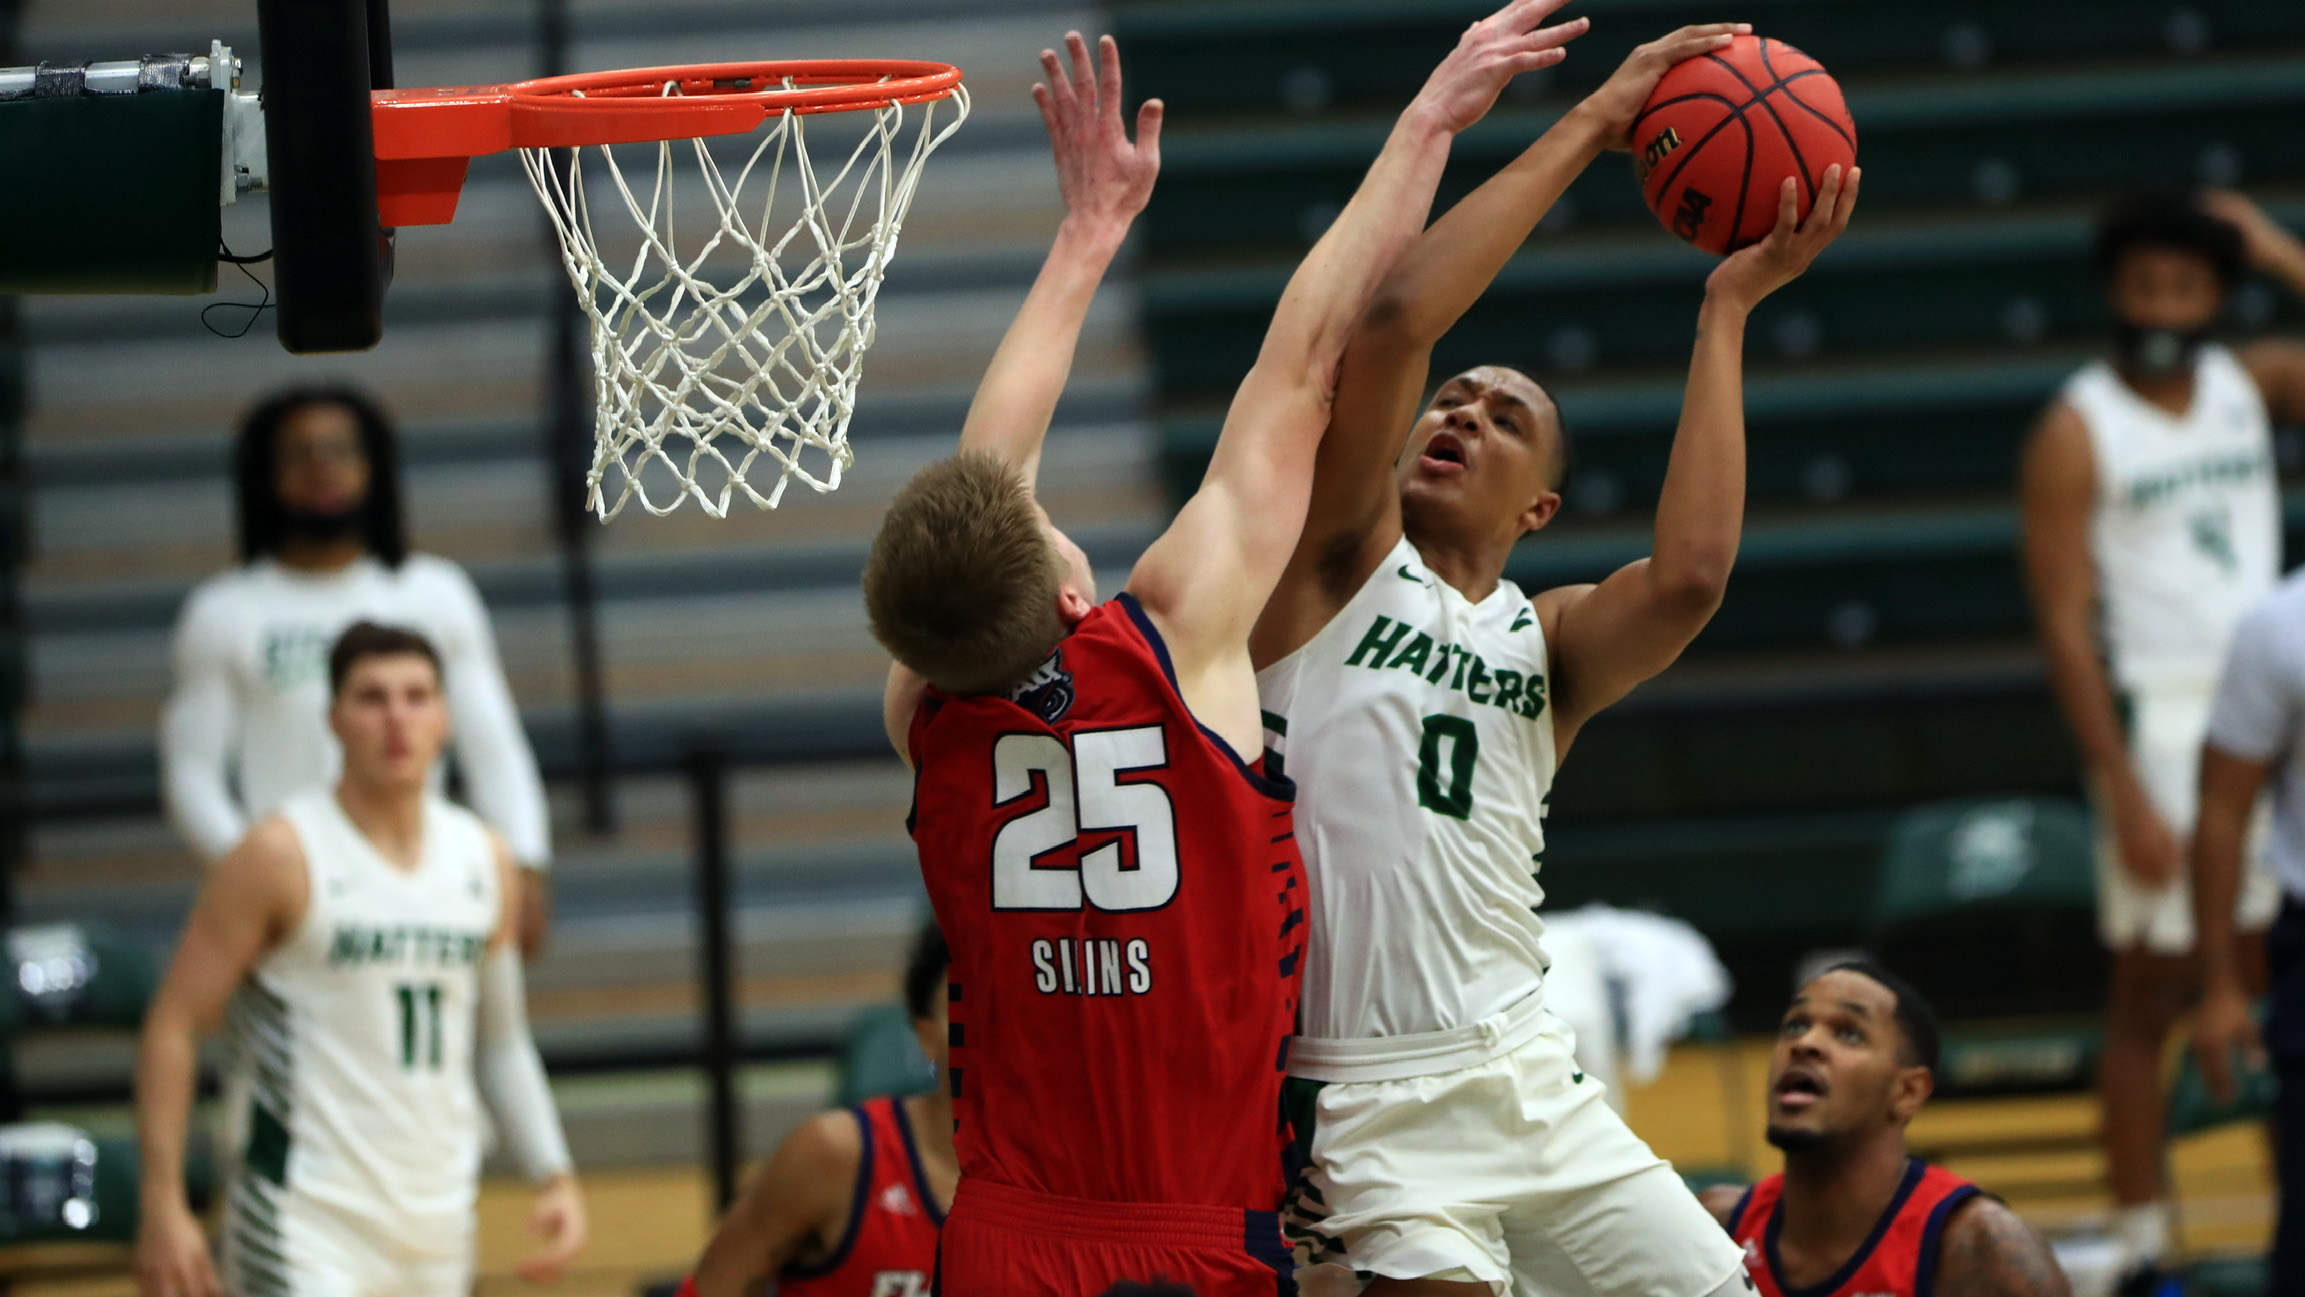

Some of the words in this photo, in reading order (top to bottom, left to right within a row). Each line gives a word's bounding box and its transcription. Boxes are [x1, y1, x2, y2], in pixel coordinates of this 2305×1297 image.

[1344, 614, 1547, 721] HATTERS
[991, 722, 1182, 915] 25
[1417, 713, 1478, 822] 0
[395, 983, 443, 1073] 11
